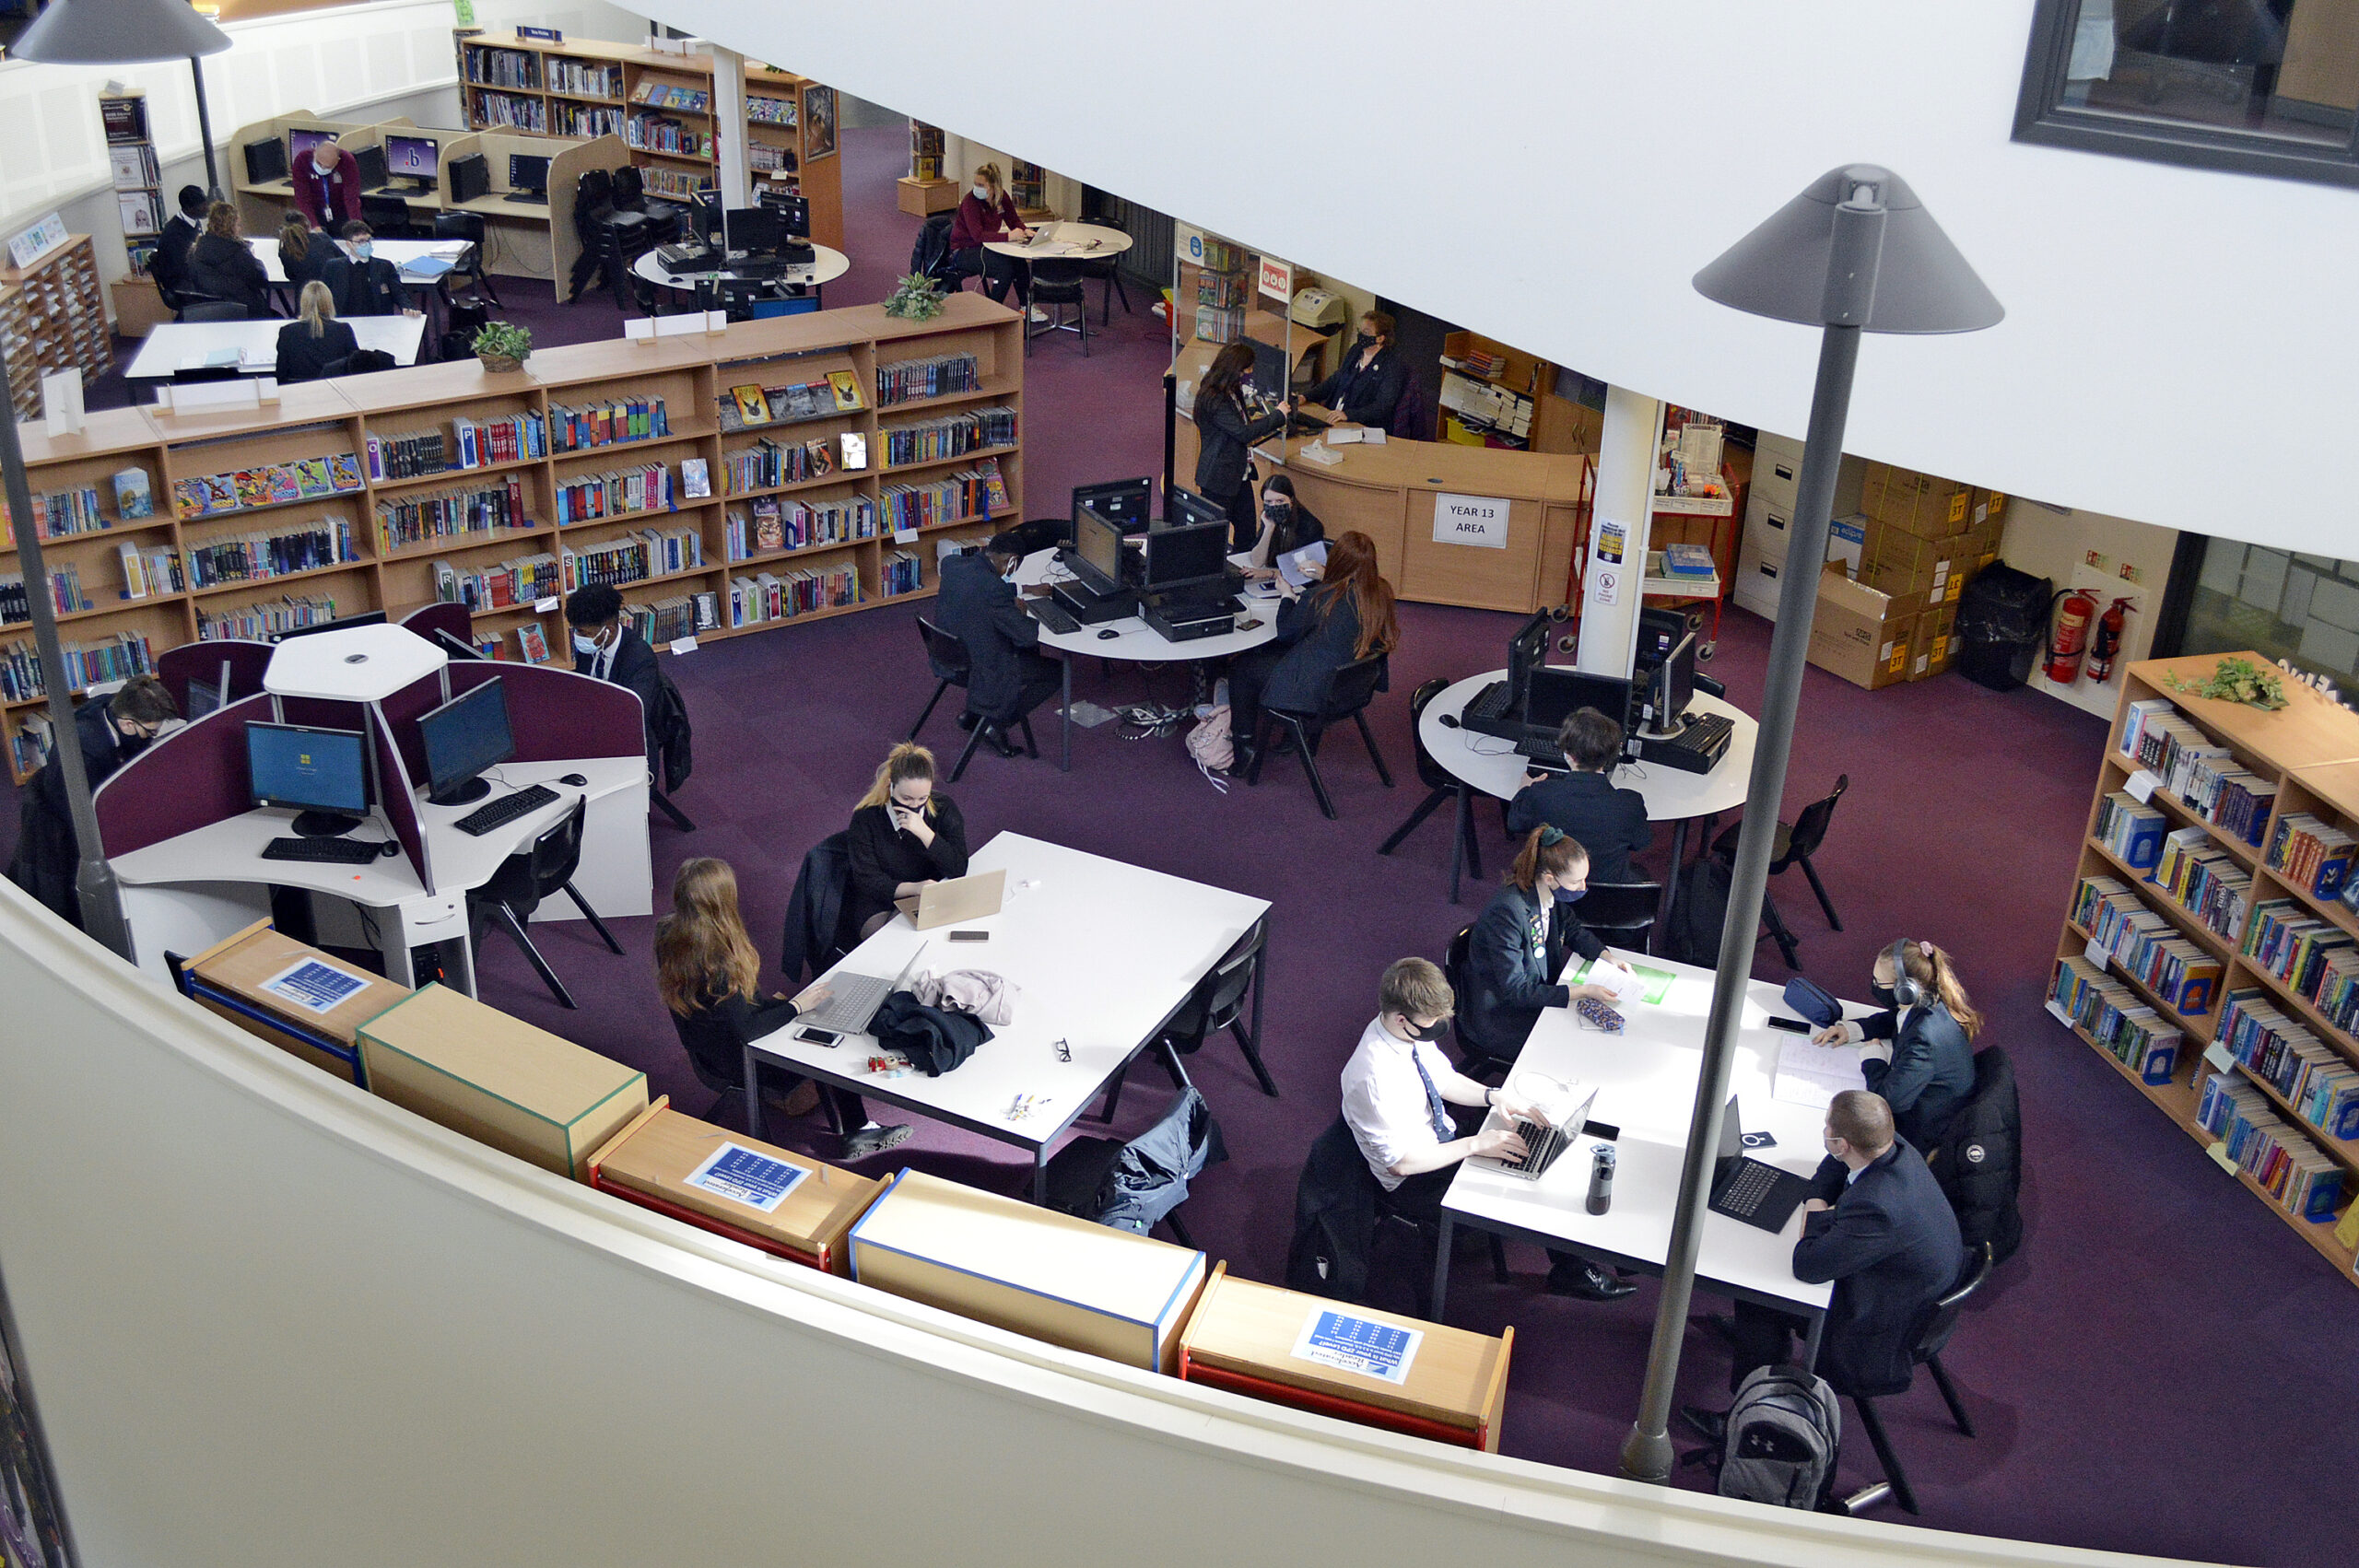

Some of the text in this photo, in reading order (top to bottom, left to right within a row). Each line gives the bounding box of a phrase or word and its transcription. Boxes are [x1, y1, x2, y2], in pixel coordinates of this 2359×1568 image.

[464, 429, 472, 440] P
[1450, 505, 1494, 518] YEAR 13
[1455, 523, 1485, 534] AREA
[565, 558, 573, 567] S
[443, 575, 451, 584] R
[748, 589, 756, 598] V
[770, 585, 779, 594] W
[732, 594, 740, 604] U
[1932, 646, 1943, 658] 3T
[1892, 655, 1904, 668] 3T
[702, 1180, 745, 1198] Accelerated
[761, 1189, 778, 1198] What
[1318, 1340, 1341, 1349] Level?
[1333, 1352, 1365, 1363] Reader
[1355, 1349, 1372, 1357] your
[1310, 1350, 1363, 1369] Accelerated
[1378, 1356, 1399, 1366] What
